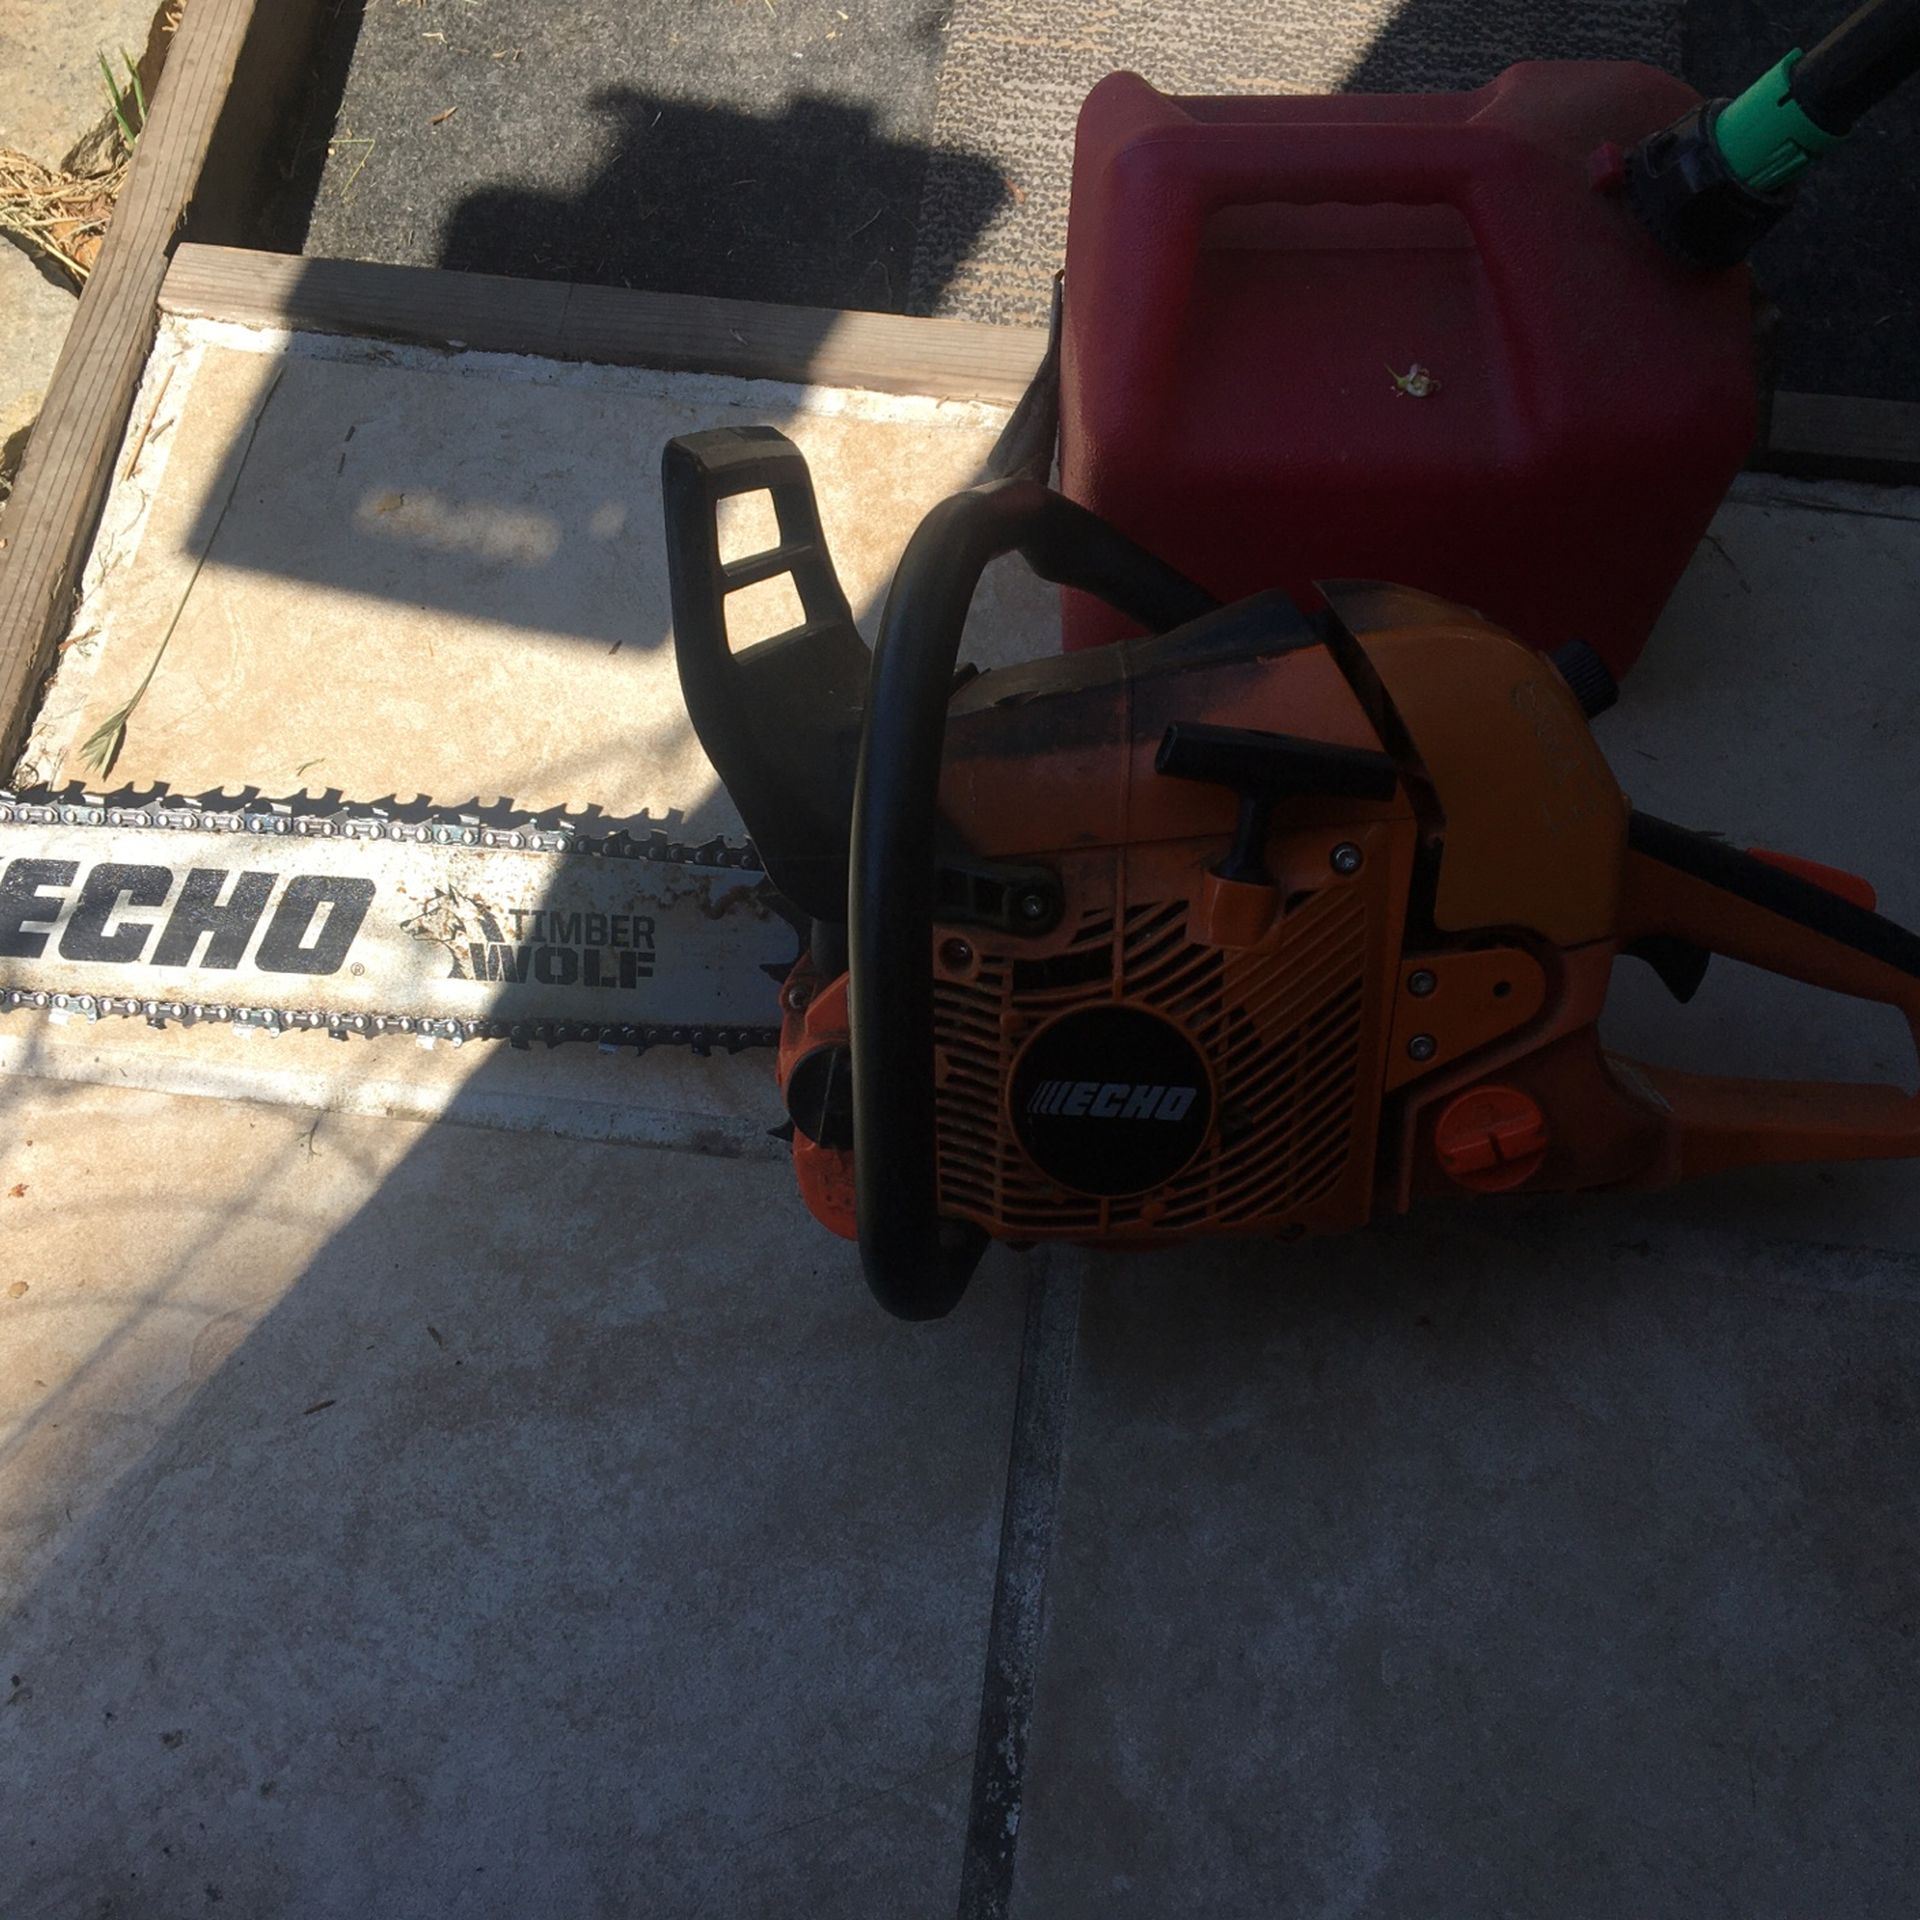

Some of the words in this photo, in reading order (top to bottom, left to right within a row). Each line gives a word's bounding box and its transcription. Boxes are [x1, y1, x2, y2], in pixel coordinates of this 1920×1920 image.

[0, 858, 376, 975] ECHO
[508, 908, 655, 949] TIMBER
[469, 942, 656, 989] WOLF
[1060, 1081, 1198, 1121] ECHO
